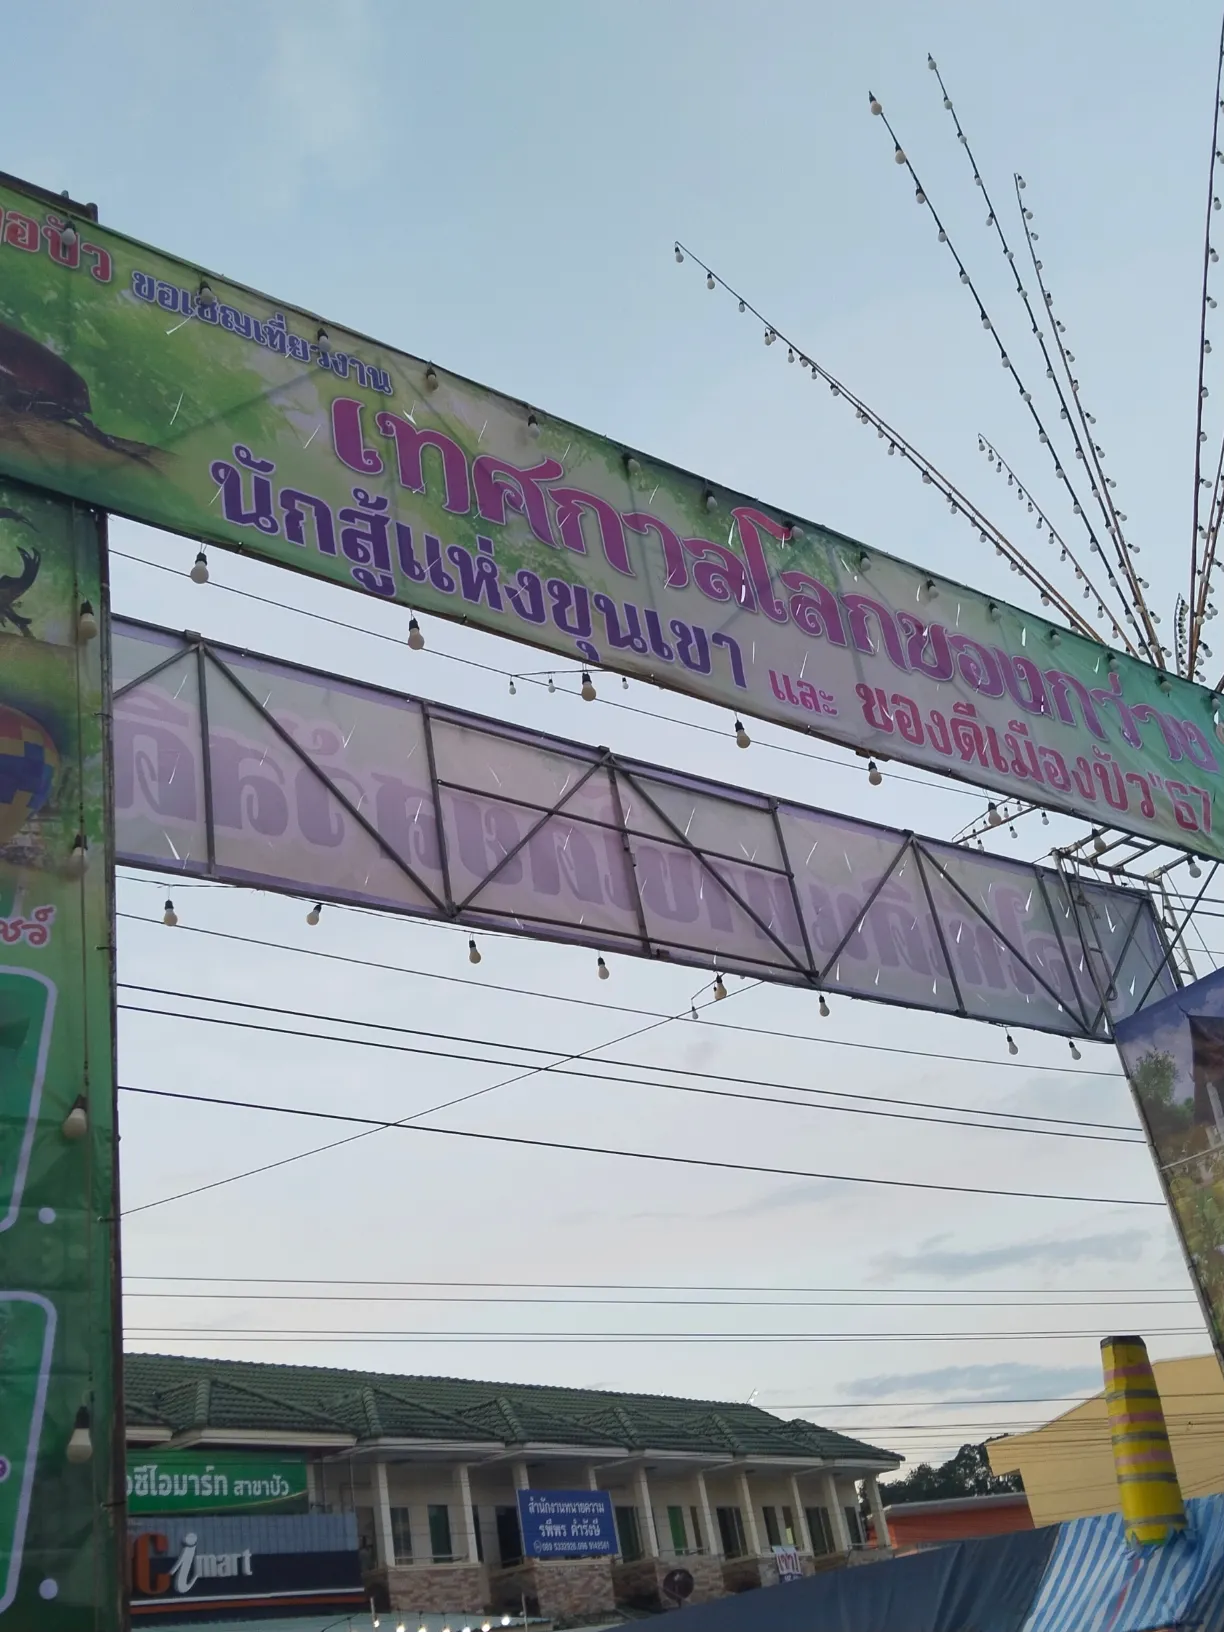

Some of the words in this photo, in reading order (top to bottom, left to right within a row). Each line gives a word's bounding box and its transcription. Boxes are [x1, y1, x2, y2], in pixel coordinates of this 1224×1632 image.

[0, 207, 112, 284] อปัว
[131, 269, 394, 397] ขอเชญเที่ยวงาน
[210, 443, 748, 690] นักสู้แห่งขุนเขา
[768, 669, 840, 717] และ
[331, 396, 1221, 774] เทศกาลโลกของกว่าง
[233, 1474, 290, 1497] สาขาปัว
[528, 1496, 605, 1515] สำนักงานทนายความ
